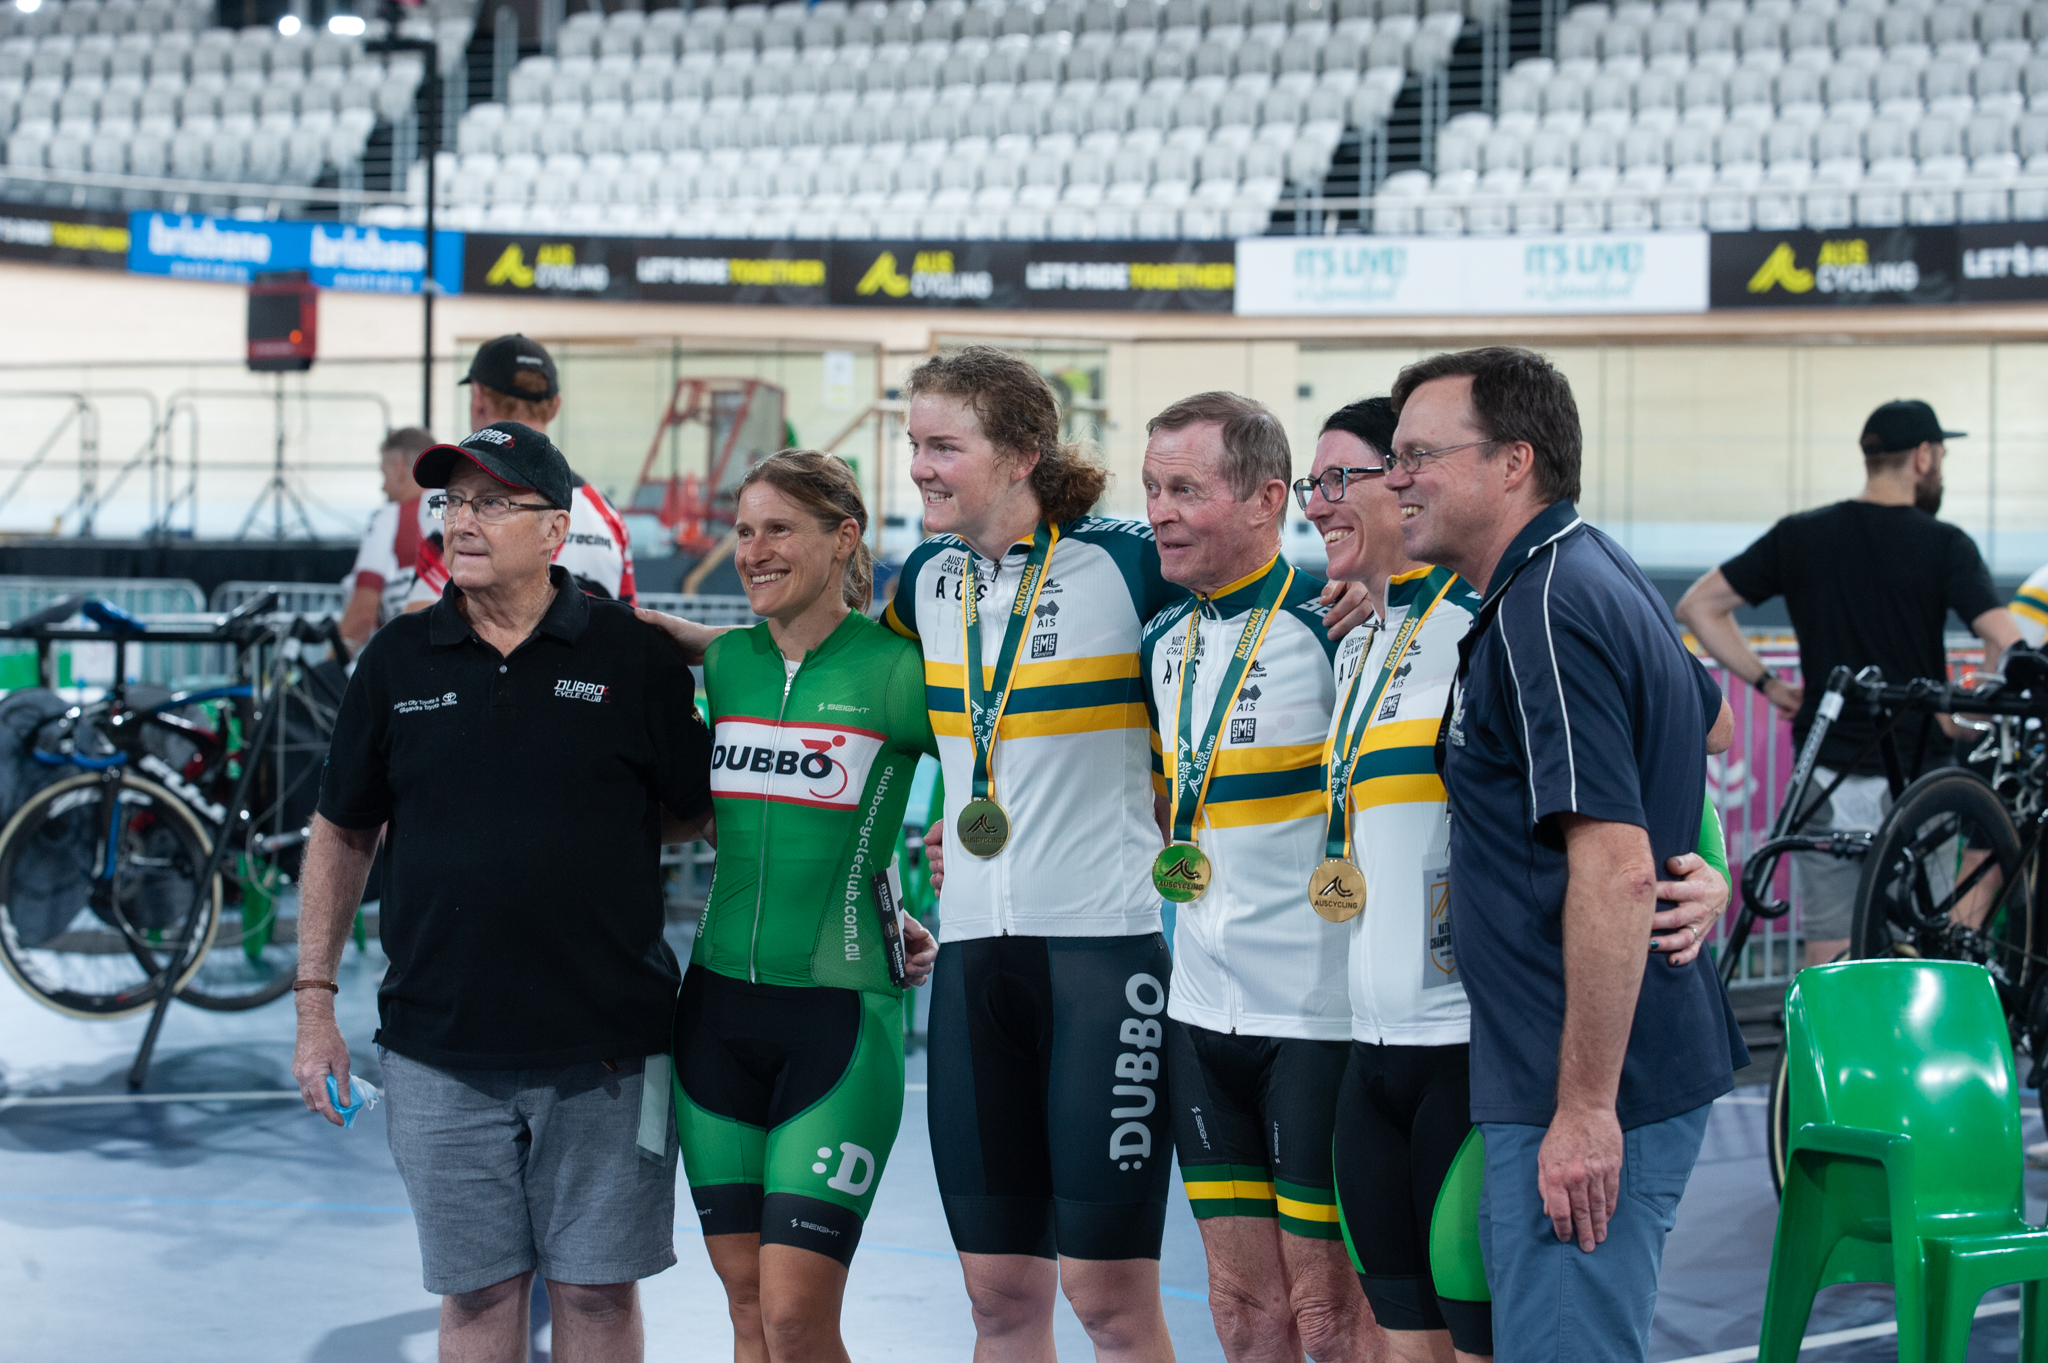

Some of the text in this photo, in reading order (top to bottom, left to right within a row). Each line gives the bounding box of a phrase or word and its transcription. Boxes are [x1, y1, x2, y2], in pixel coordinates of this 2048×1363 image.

[309, 224, 427, 273] brisban
[1817, 238, 1869, 266] AUS
[534, 264, 610, 291] CYCLING
[910, 270, 993, 299] CYCLING
[1815, 260, 1920, 294] CYCLING
[1012, 563, 1036, 615] NATIONAL
[1020, 564, 1042, 617] CHAMPIONSHIPS
[1037, 618, 1056, 628] AIS
[1235, 607, 1264, 659] NATIONAL
[1242, 608, 1269, 661] CHAMPIONSHIPS
[1384, 616, 1415, 669] NATIONAL
[1389, 617, 1419, 670] CHAMPIONSHIPS
[1337, 655, 1359, 688] AU
[1389, 678, 1405, 690] AIS
[553, 679, 605, 696] DUBBO
[554, 690, 602, 703] CYCLE CLUB
[418, 698, 435, 706] Toyota
[827, 703, 870, 714] SEIGHT
[989, 691, 1003, 727] CYCLING
[1236, 702, 1256, 712] AIS
[712, 744, 833, 780] DUBBO
[1193, 751, 1204, 769] AUS
[1199, 734, 1216, 771] CYCLING
[963, 837, 1004, 845] AUSCYCLING
[844, 765, 894, 961] dubbocycleclub.com.au
[1158, 880, 1204, 891] AUSCYCLING
[1314, 899, 1358, 909] AUSCYCLING
[800, 1220, 840, 1237] SEIGHT
